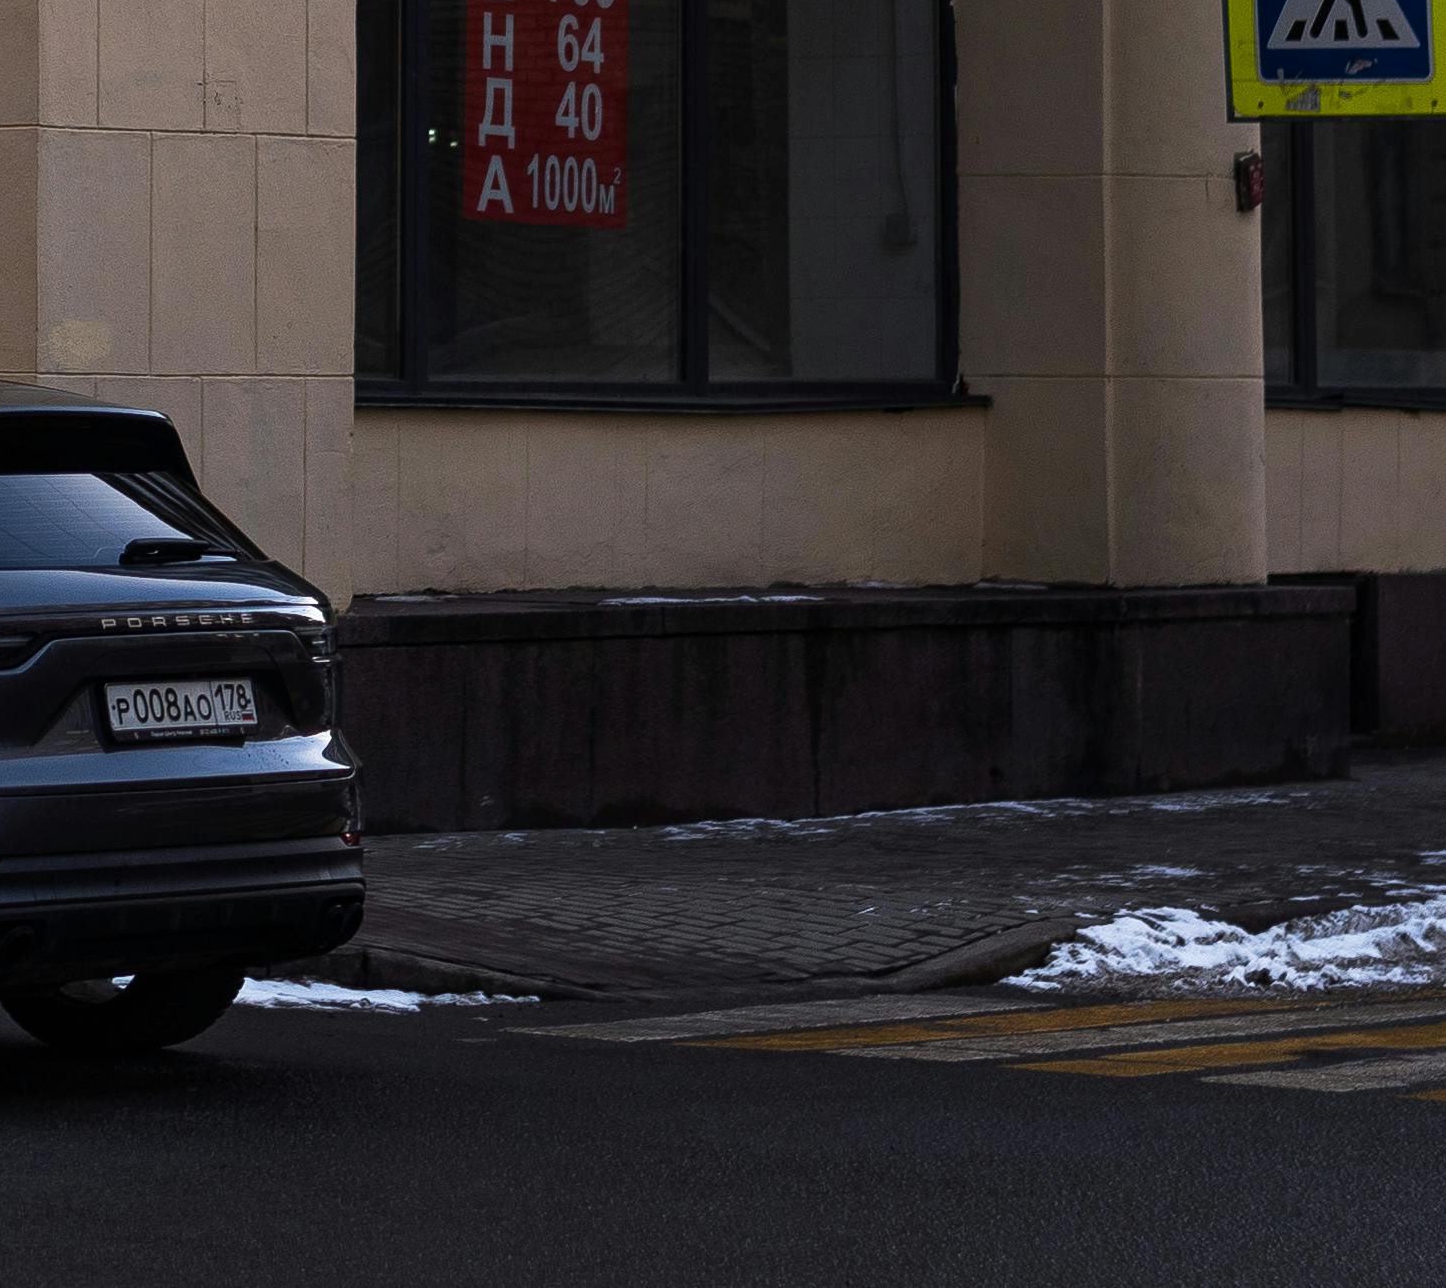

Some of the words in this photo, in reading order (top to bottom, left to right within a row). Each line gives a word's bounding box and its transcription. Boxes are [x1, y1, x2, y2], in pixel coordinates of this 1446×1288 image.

[555, 15, 605, 75] 64
[554, 80, 604, 142] 40
[101, 613, 254, 630] PORSCHE
[213, 683, 249, 711] 178
[224, 710, 242, 722] RUS
